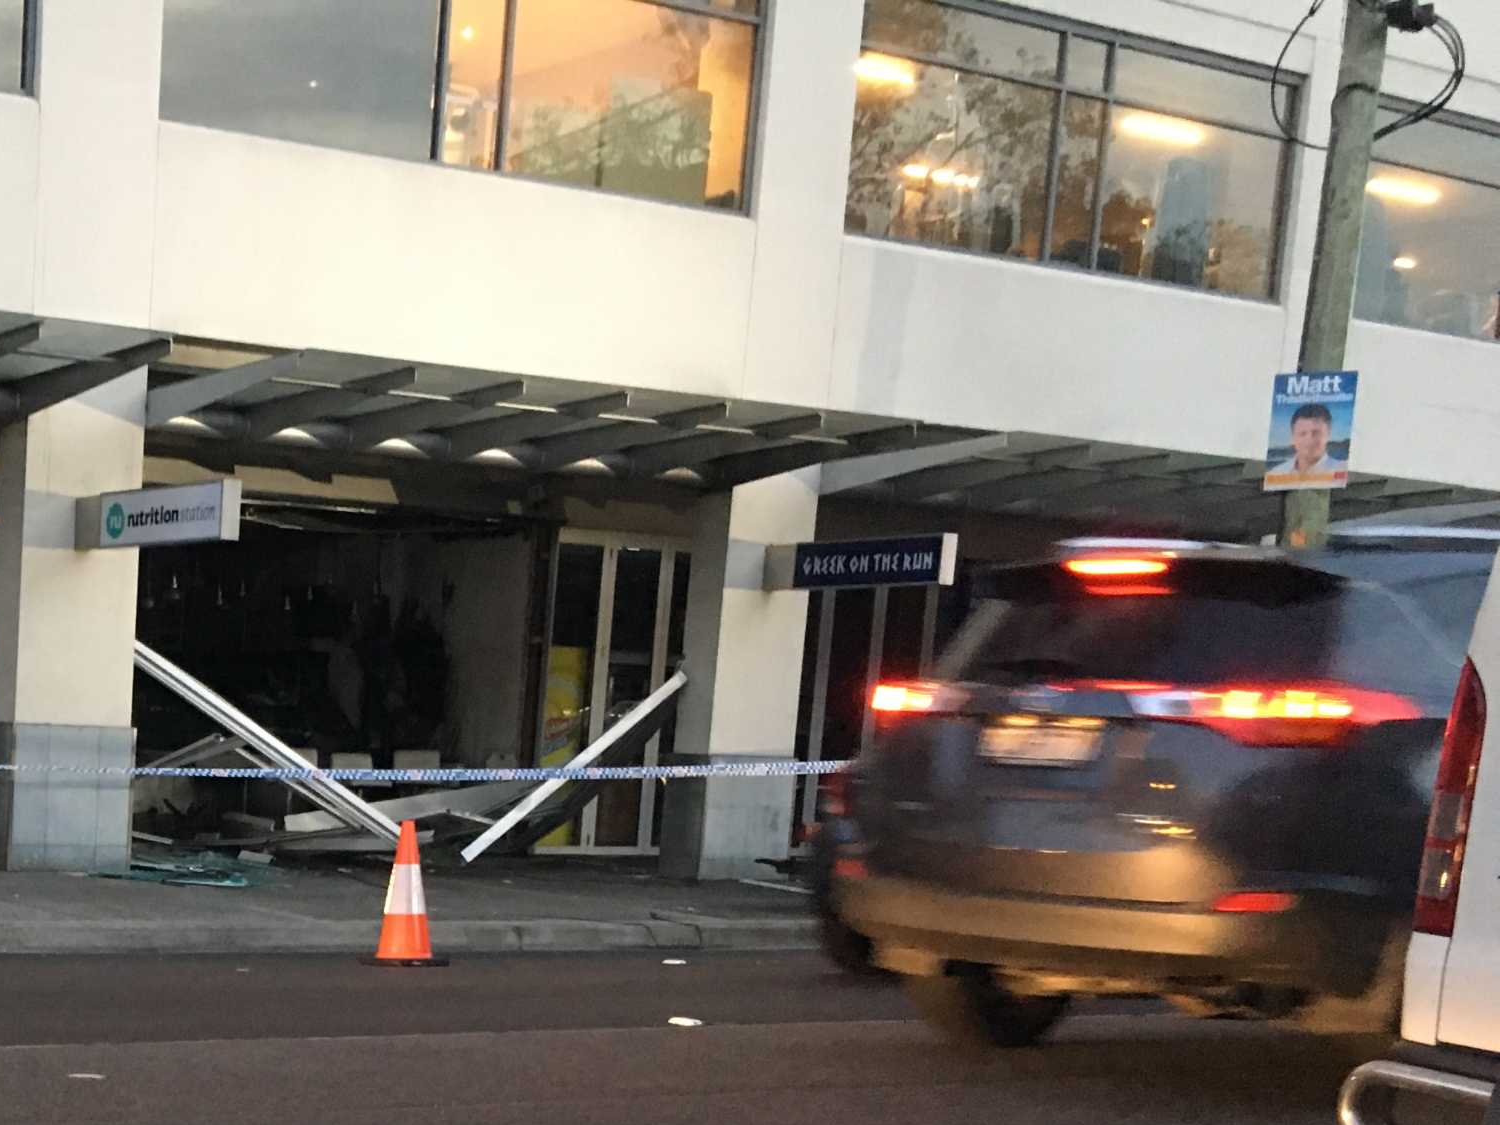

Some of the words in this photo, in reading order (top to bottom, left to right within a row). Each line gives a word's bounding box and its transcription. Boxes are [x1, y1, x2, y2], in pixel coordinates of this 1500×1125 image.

[1286, 375, 1342, 394] Matt
[127, 505, 179, 528] nutrition
[803, 554, 846, 576] GREEK
[849, 553, 870, 574] ON
[874, 552, 900, 572] THE
[902, 551, 934, 571] RUN
